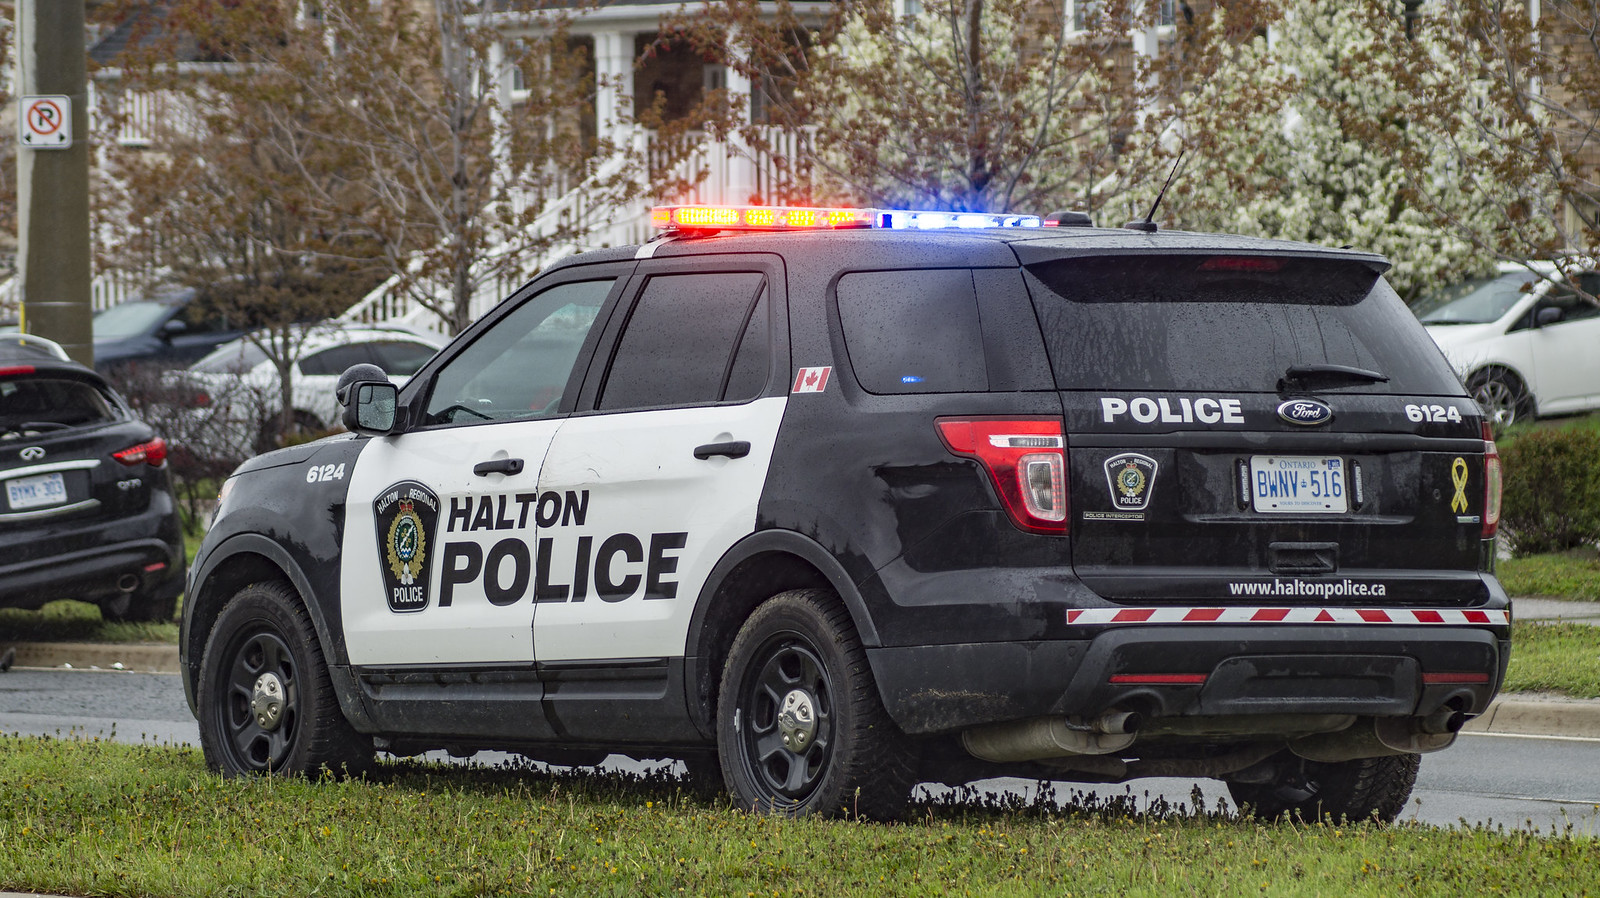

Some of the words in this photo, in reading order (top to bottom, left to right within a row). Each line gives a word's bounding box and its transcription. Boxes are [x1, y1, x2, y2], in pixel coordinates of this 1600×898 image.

[1101, 397, 1245, 423] POLICE
[1292, 403, 1321, 418] Ford
[1405, 404, 1462, 423] 6124
[306, 463, 345, 483] 6124
[1280, 461, 1316, 469] ONTARIO
[1257, 470, 1298, 498] BWNV
[1310, 470, 1342, 498] 516
[377, 491, 399, 514] HALTON
[409, 488, 436, 512] REGIONAL
[446, 489, 590, 533] HALTON
[438, 531, 689, 608] POLICE
[394, 586, 424, 603] POLICE
[1229, 578, 1386, 600] www.haltonpolice.ca
